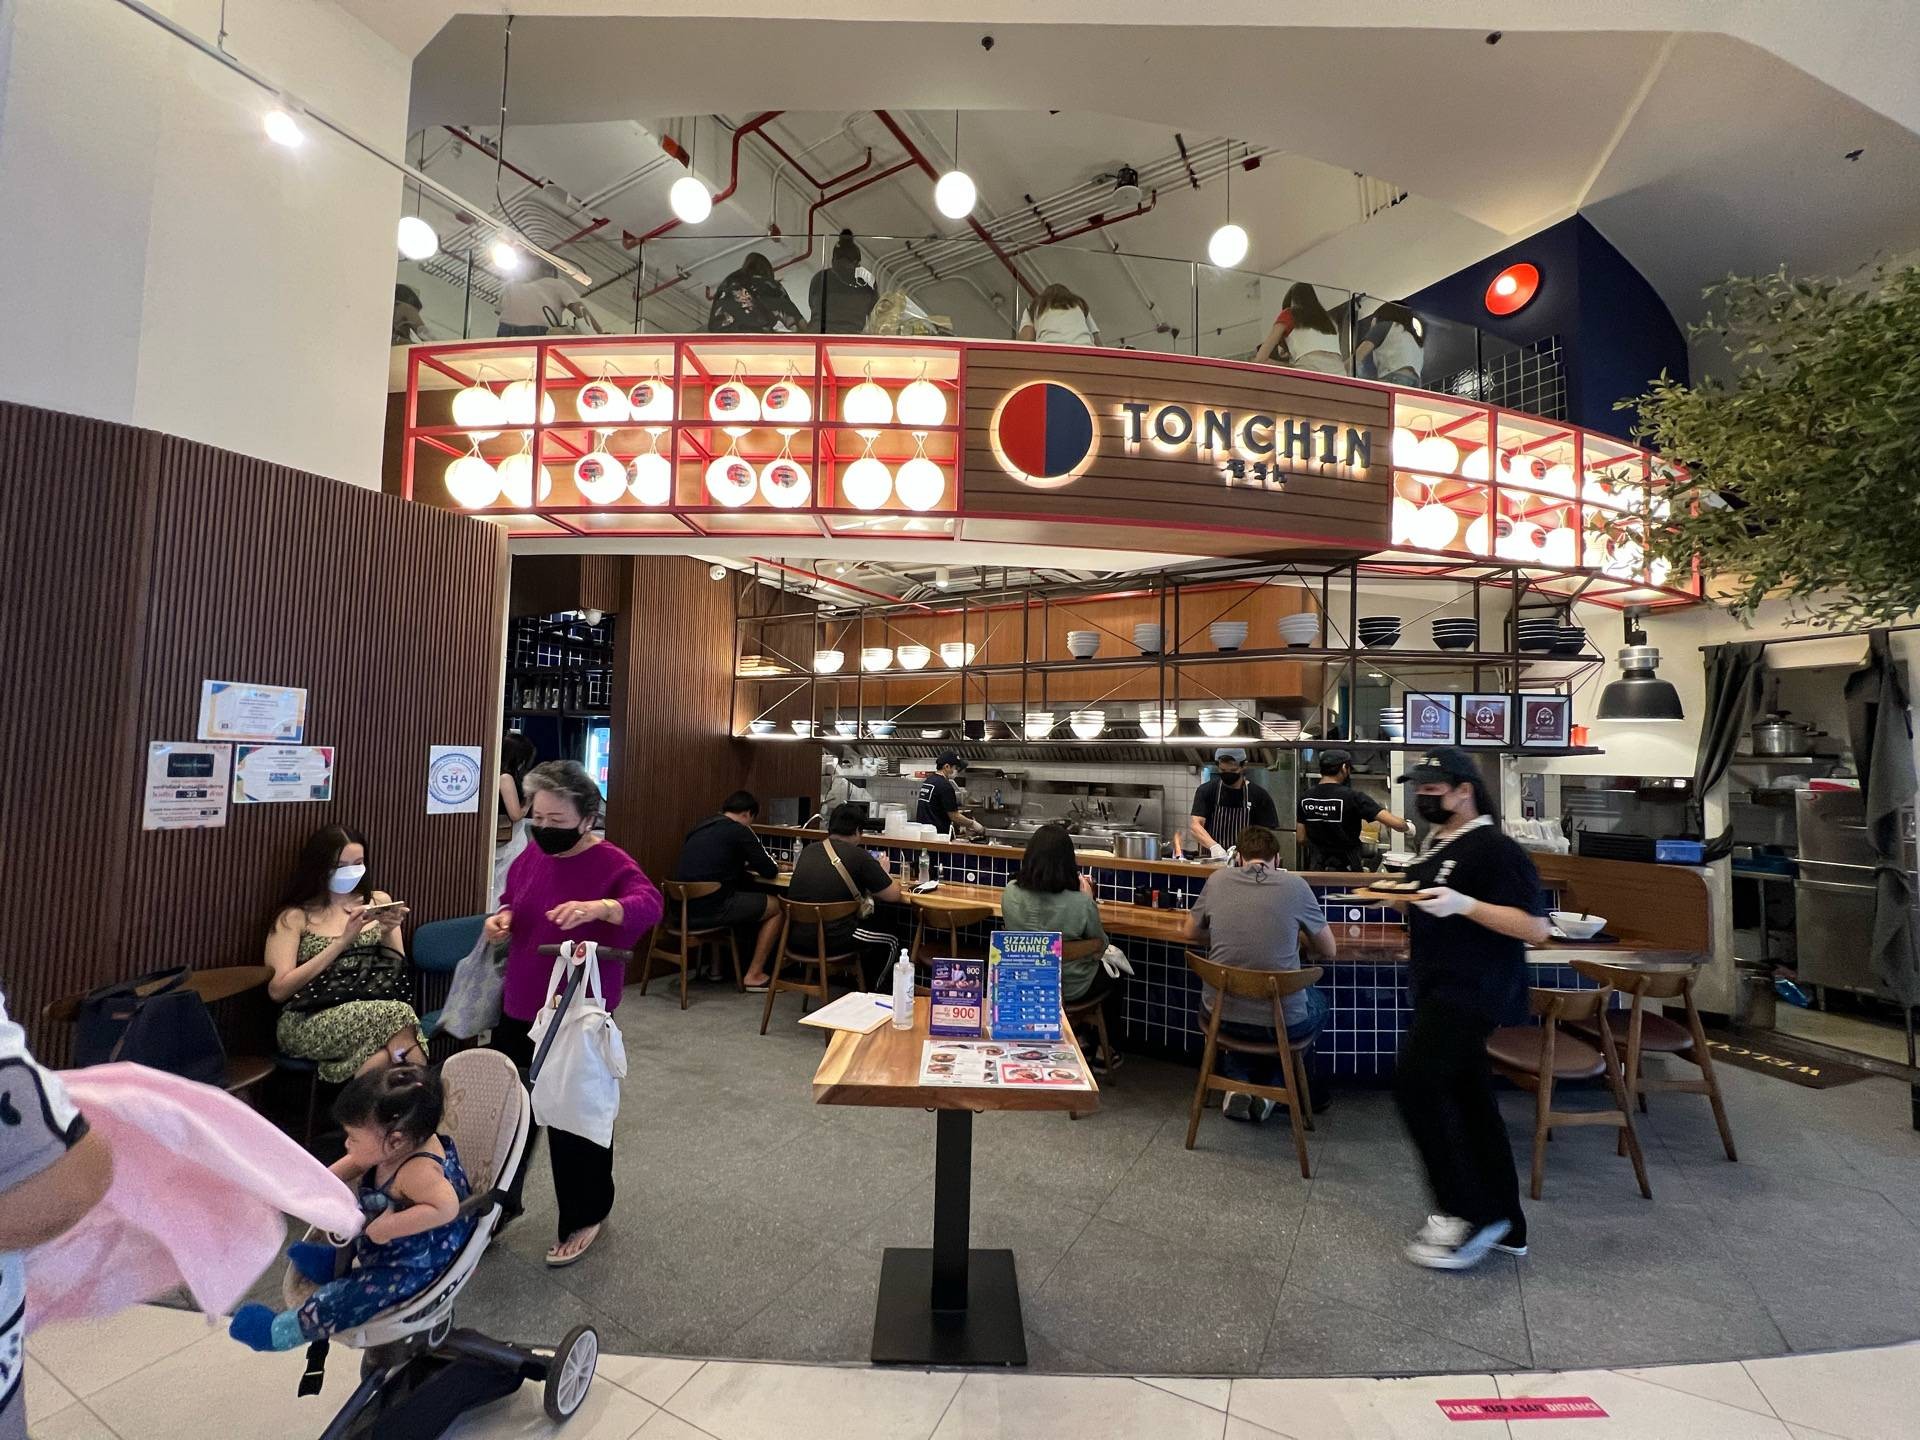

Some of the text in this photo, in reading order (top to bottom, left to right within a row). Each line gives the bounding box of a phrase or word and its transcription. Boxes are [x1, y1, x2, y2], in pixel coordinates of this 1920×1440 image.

[1122, 403, 1372, 468] TONCHIN
[441, 774, 468, 784] SHA
[1003, 936, 1050, 945] SIZZLING
[1004, 944, 1047, 953] SUMMER
